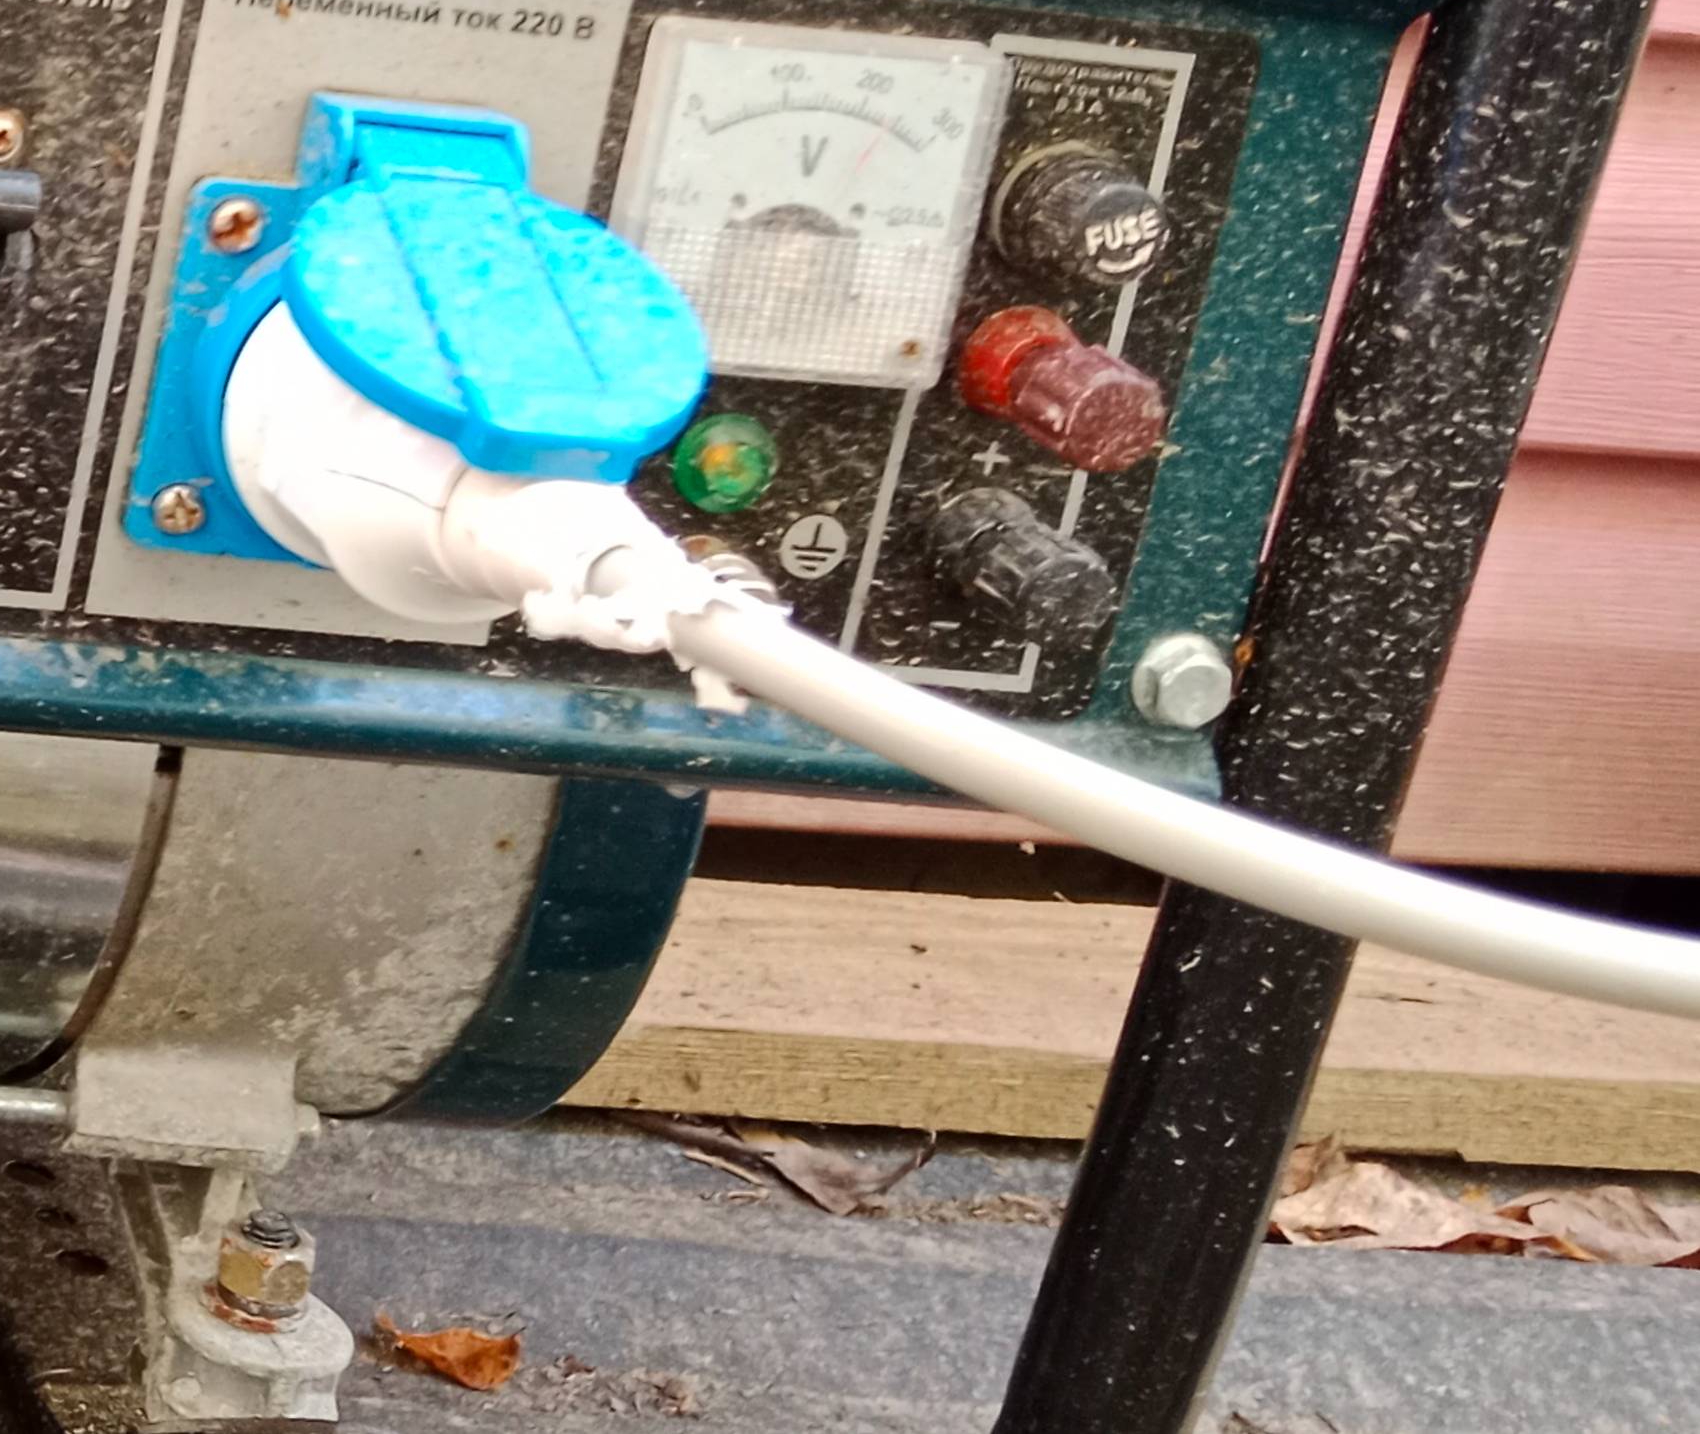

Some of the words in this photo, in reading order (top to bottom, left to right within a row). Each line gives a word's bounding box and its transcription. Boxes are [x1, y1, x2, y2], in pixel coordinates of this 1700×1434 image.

[452, 8, 502, 31] ток
[511, 8, 563, 37] 220
[799, 134, 830, 178] V
[1084, 208, 1161, 257] FUSE
